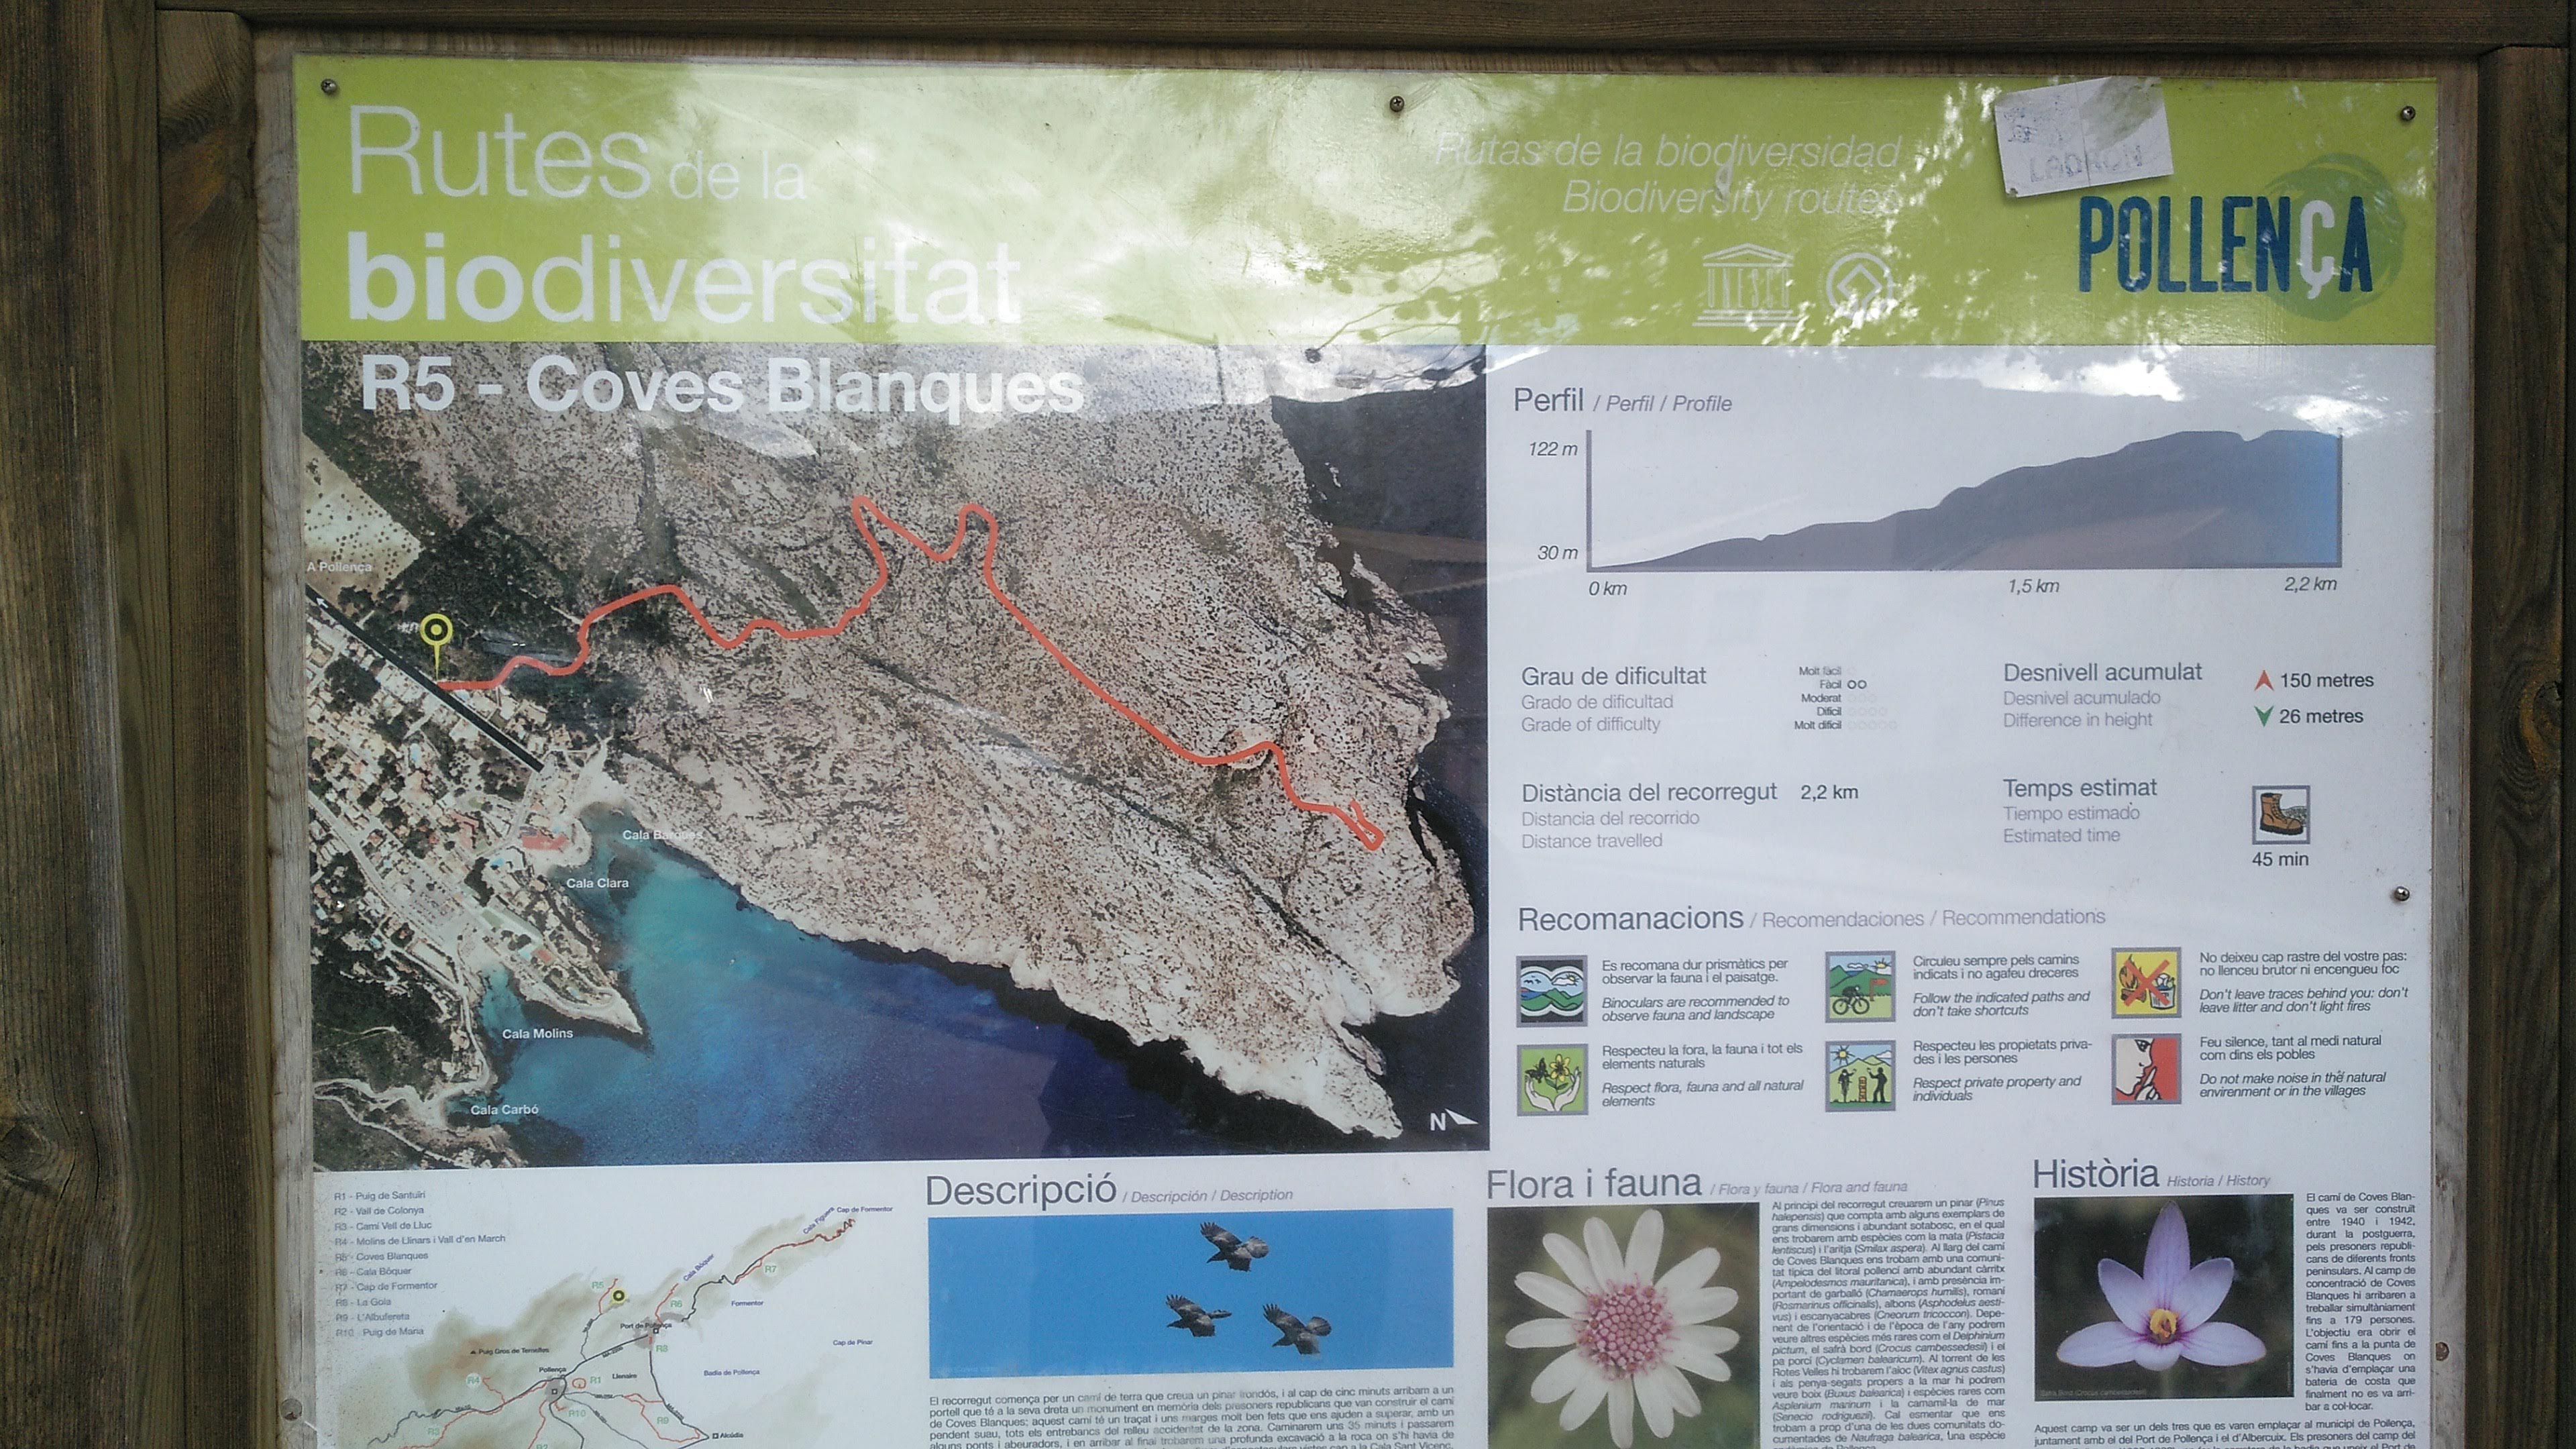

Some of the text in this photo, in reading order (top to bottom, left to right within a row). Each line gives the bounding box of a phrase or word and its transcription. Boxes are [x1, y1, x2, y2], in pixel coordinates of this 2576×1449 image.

[351, 105, 806, 200] Rutes de la
[1435, 133, 1901, 168] Rutas de la biodiversidad
[1563, 179, 1772, 220] Biodiversity
[2080, 195, 2372, 300] POLLENÇA
[347, 231, 1021, 325] biodiversitat
[363, 354, 455, 411] R5
[527, 354, 743, 413] Coves
[768, 358, 1085, 426] Blanques
[1515, 387, 1583, 412] Perfil
[1606, 394, 1655, 412] Perfil
[1672, 394, 1733, 412] Profile
[1529, 441, 1578, 456] 122 m
[1538, 545, 1578, 560] 30 m
[307, 562, 372, 574] A Pollença
[1589, 580, 1627, 596] 0 km
[2009, 578, 2060, 596] 1,5 km
[2284, 576, 2338, 594] 2,2 km
[1521, 665, 1707, 686] Grau de dificultat
[2004, 661, 2203, 682] Desnivell acumulat
[2281, 672, 2375, 688] 150 metres
[1521, 694, 1674, 710] Grado de dificultad
[1801, 694, 1841, 702] Moderat
[2004, 690, 2161, 706] Desnivel acumulado
[2004, 711, 2153, 731] Difference in height
[2279, 708, 2364, 724] 26 metres
[1521, 716, 1661, 735] Grade of difficulty
[1794, 720, 1815, 729] Molt
[1523, 782, 1778, 805] Distància del recorregut
[1801, 784, 1859, 802] 2,2 km
[2002, 777, 2158, 802] Temps estimat
[1522, 810, 1700, 826] Distancia del recorrido
[2002, 805, 2141, 824] Tiempo estimado
[623, 830, 650, 841] Cala
[1521, 833, 1663, 849] Distance travelled
[2004, 827, 2121, 843] Estimated time
[2251, 851, 2309, 867] 45 min
[566, 877, 629, 890] Cala Clara
[1519, 905, 1744, 931] Recomanacions
[1763, 911, 1925, 928] Recomendaciones
[1943, 908, 2106, 926] Recommendations
[1602, 958, 1789, 975] Es recomana dur prismàtics per
[1601, 973, 1654, 985] observar
[1656, 972, 1667, 984] la
[1670, 972, 1703, 983] fauna
[1711, 971, 1722, 983] el
[1725, 971, 1778, 985] paisatge.
[1913, 990, 2091, 1005] Follow the indicated paths and
[1913, 1005, 2029, 1018] don't take shortcuts
[502, 1028, 574, 1040] Cala Molins
[2200, 1034, 2381, 1049] Feu silence, tant al medi natural
[470, 1104, 539, 1116] Cala Carbó
[1430, 1112, 1446, 1131] N
[2034, 1157, 2160, 1189] Història
[2167, 1175, 2214, 1187] Historia
[2226, 1175, 2271, 1189] History
[1487, 1169, 1574, 1199] Flora
[1605, 1167, 1703, 1197] fauna
[1718, 1183, 1751, 1195] Flora
[1752, 1185, 1761, 1198] y
[1764, 1183, 1799, 1195] fauna
[1811, 1181, 1843, 1193] Flora
[1845, 1181, 1870, 1193] and
[1873, 1181, 1908, 1192] fauna
[356, 1193, 376, 1201] Puig
[926, 1172, 1117, 1212] Descripció
[1130, 1189, 1208, 1205] Descripción
[1220, 1189, 1293, 1203] Description
[2306, 1193, 2316, 1202] El
[2343, 1192, 2356, 1201] de
[2358, 1191, 2389, 1201] Coves
[2391, 1191, 2416, 1201] Blan-
